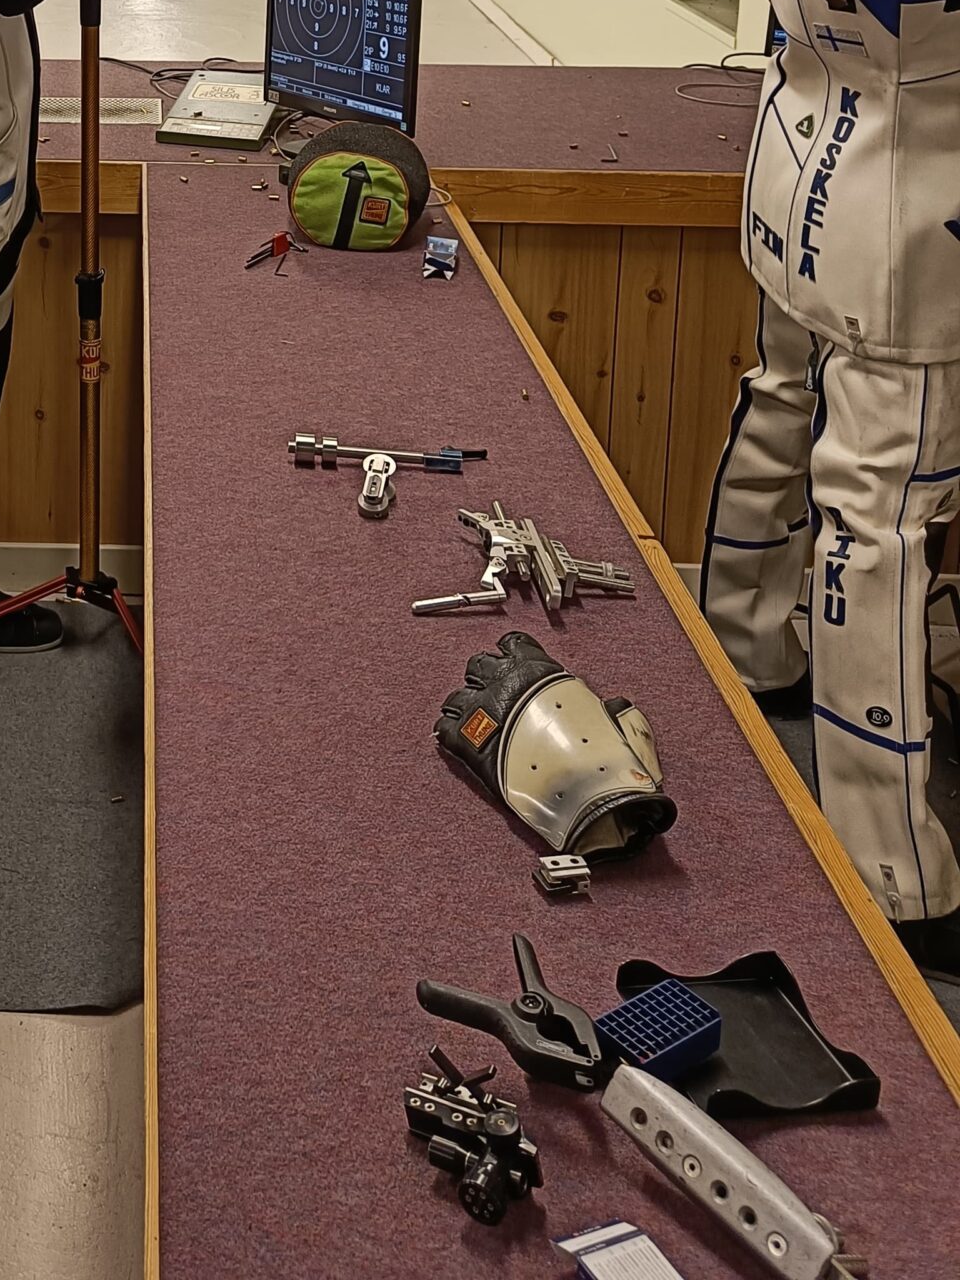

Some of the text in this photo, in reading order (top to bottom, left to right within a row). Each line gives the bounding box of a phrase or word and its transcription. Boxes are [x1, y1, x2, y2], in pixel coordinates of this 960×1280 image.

[379, 36, 389, 59] 9
[375, 83, 391, 95] KLAR
[797, 86, 862, 284] KOSKELA
[751, 211, 785, 264] FIN
